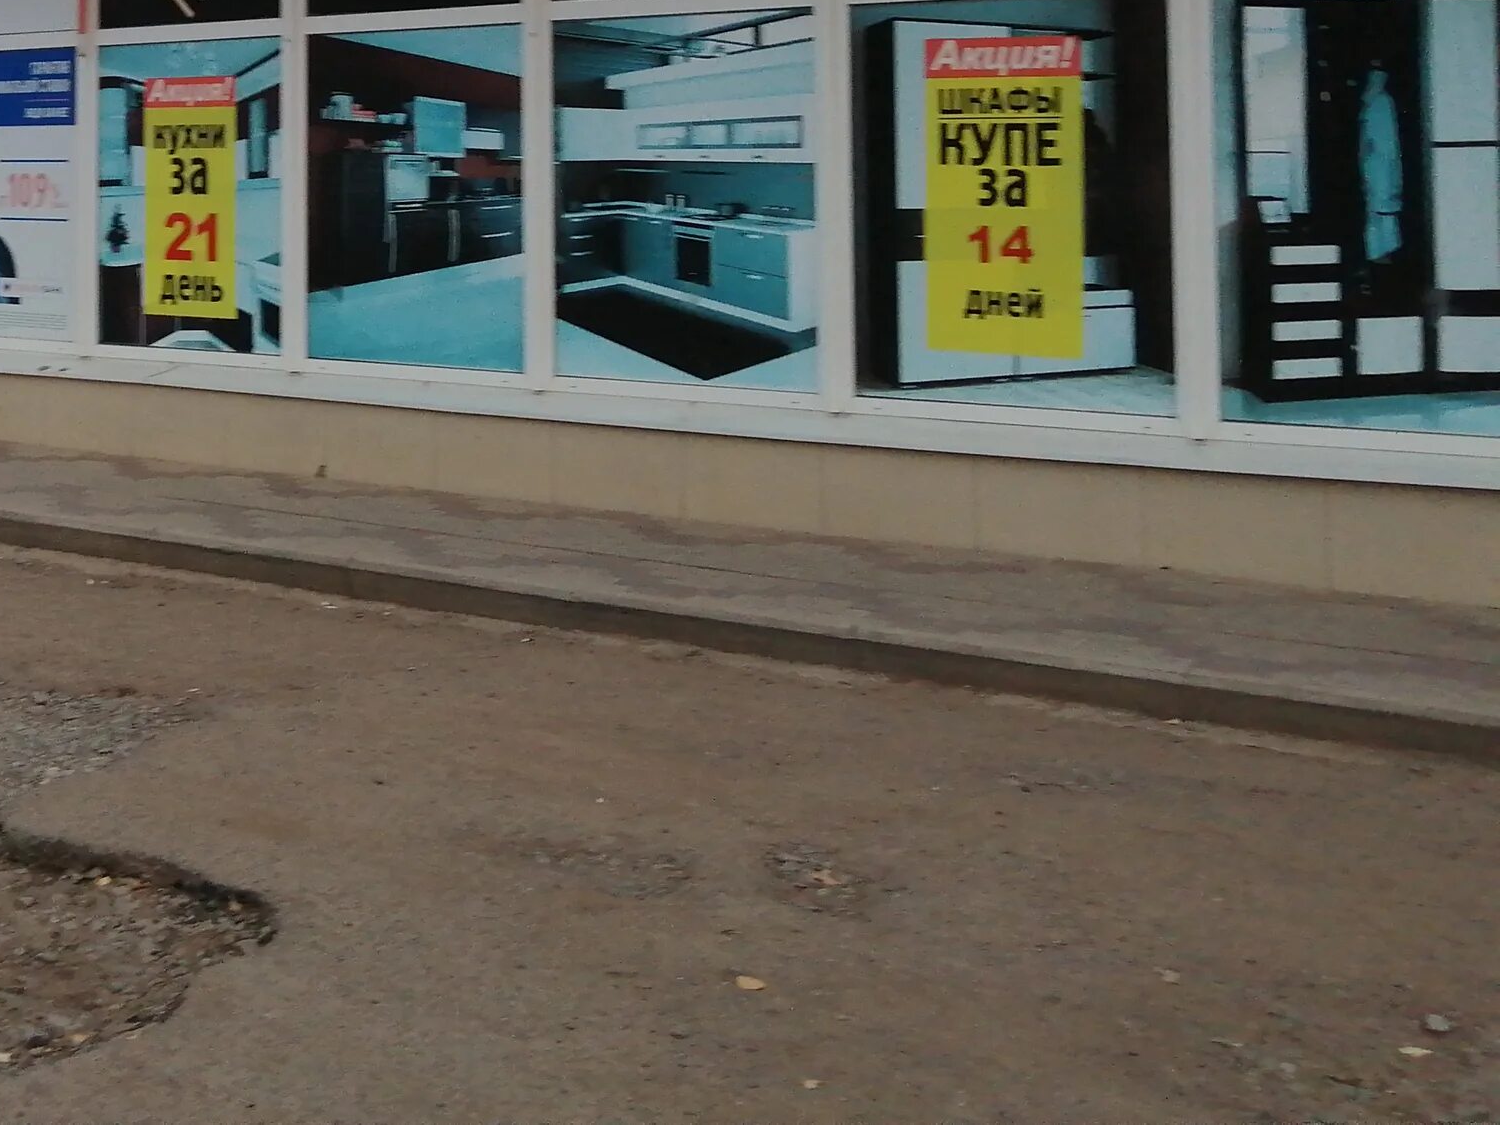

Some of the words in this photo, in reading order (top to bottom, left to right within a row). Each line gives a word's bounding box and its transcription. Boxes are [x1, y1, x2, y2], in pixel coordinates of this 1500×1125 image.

[931, 41, 1077, 75] Акция!
[147, 78, 234, 105] Акция!
[938, 87, 1063, 115] ШКАФЫ
[940, 122, 1063, 167] КУПЕ
[169, 157, 208, 195] за
[978, 169, 1028, 207] за
[165, 212, 218, 262] 21
[967, 225, 1035, 264] 14
